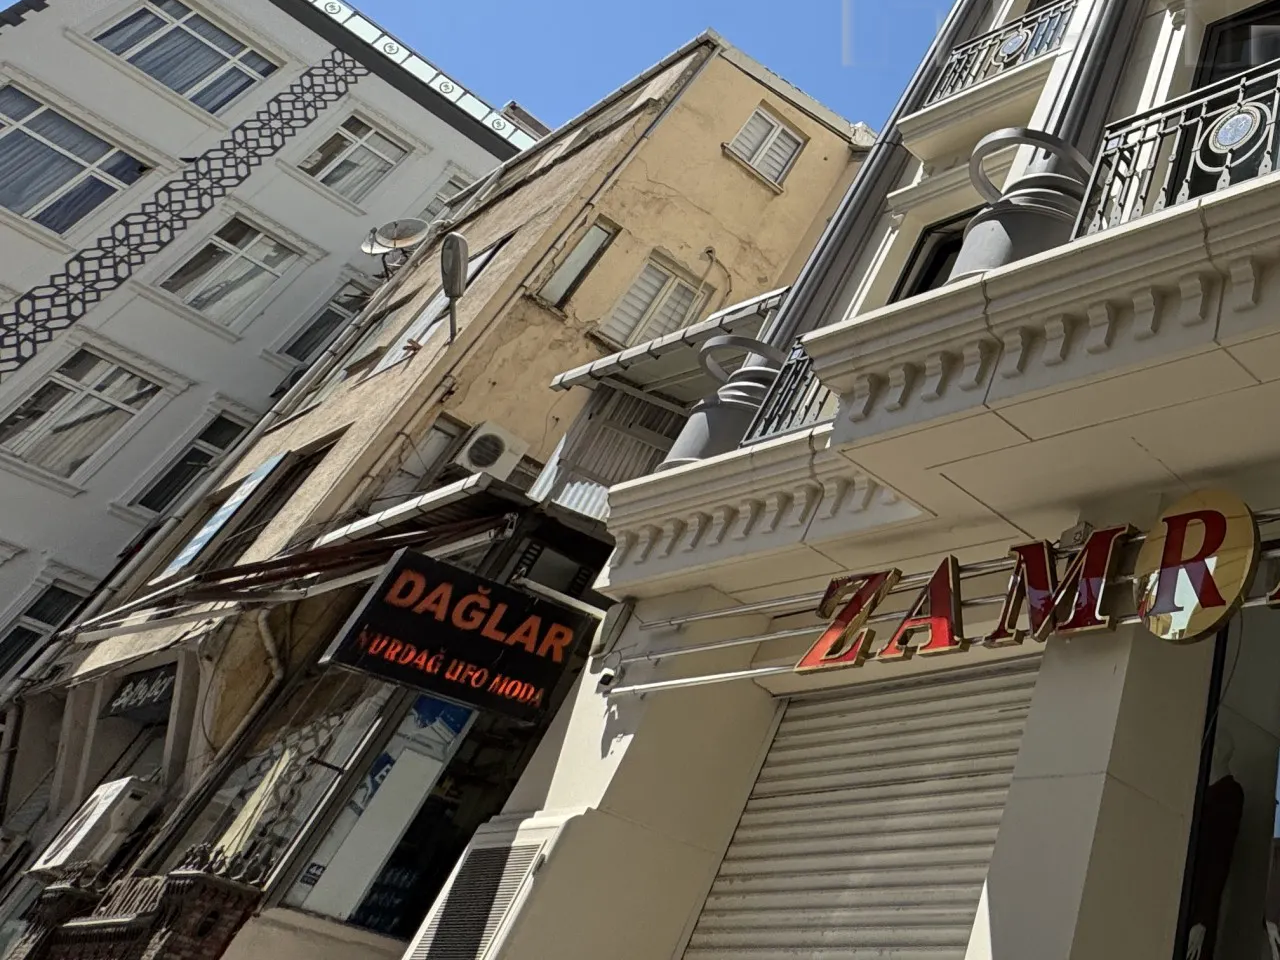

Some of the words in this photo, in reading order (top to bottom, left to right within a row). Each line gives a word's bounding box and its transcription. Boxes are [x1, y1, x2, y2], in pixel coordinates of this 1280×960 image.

[384, 568, 574, 663] DAĞLAR
[444, 660, 488, 688] UFO
[488, 673, 543, 709] MODA
